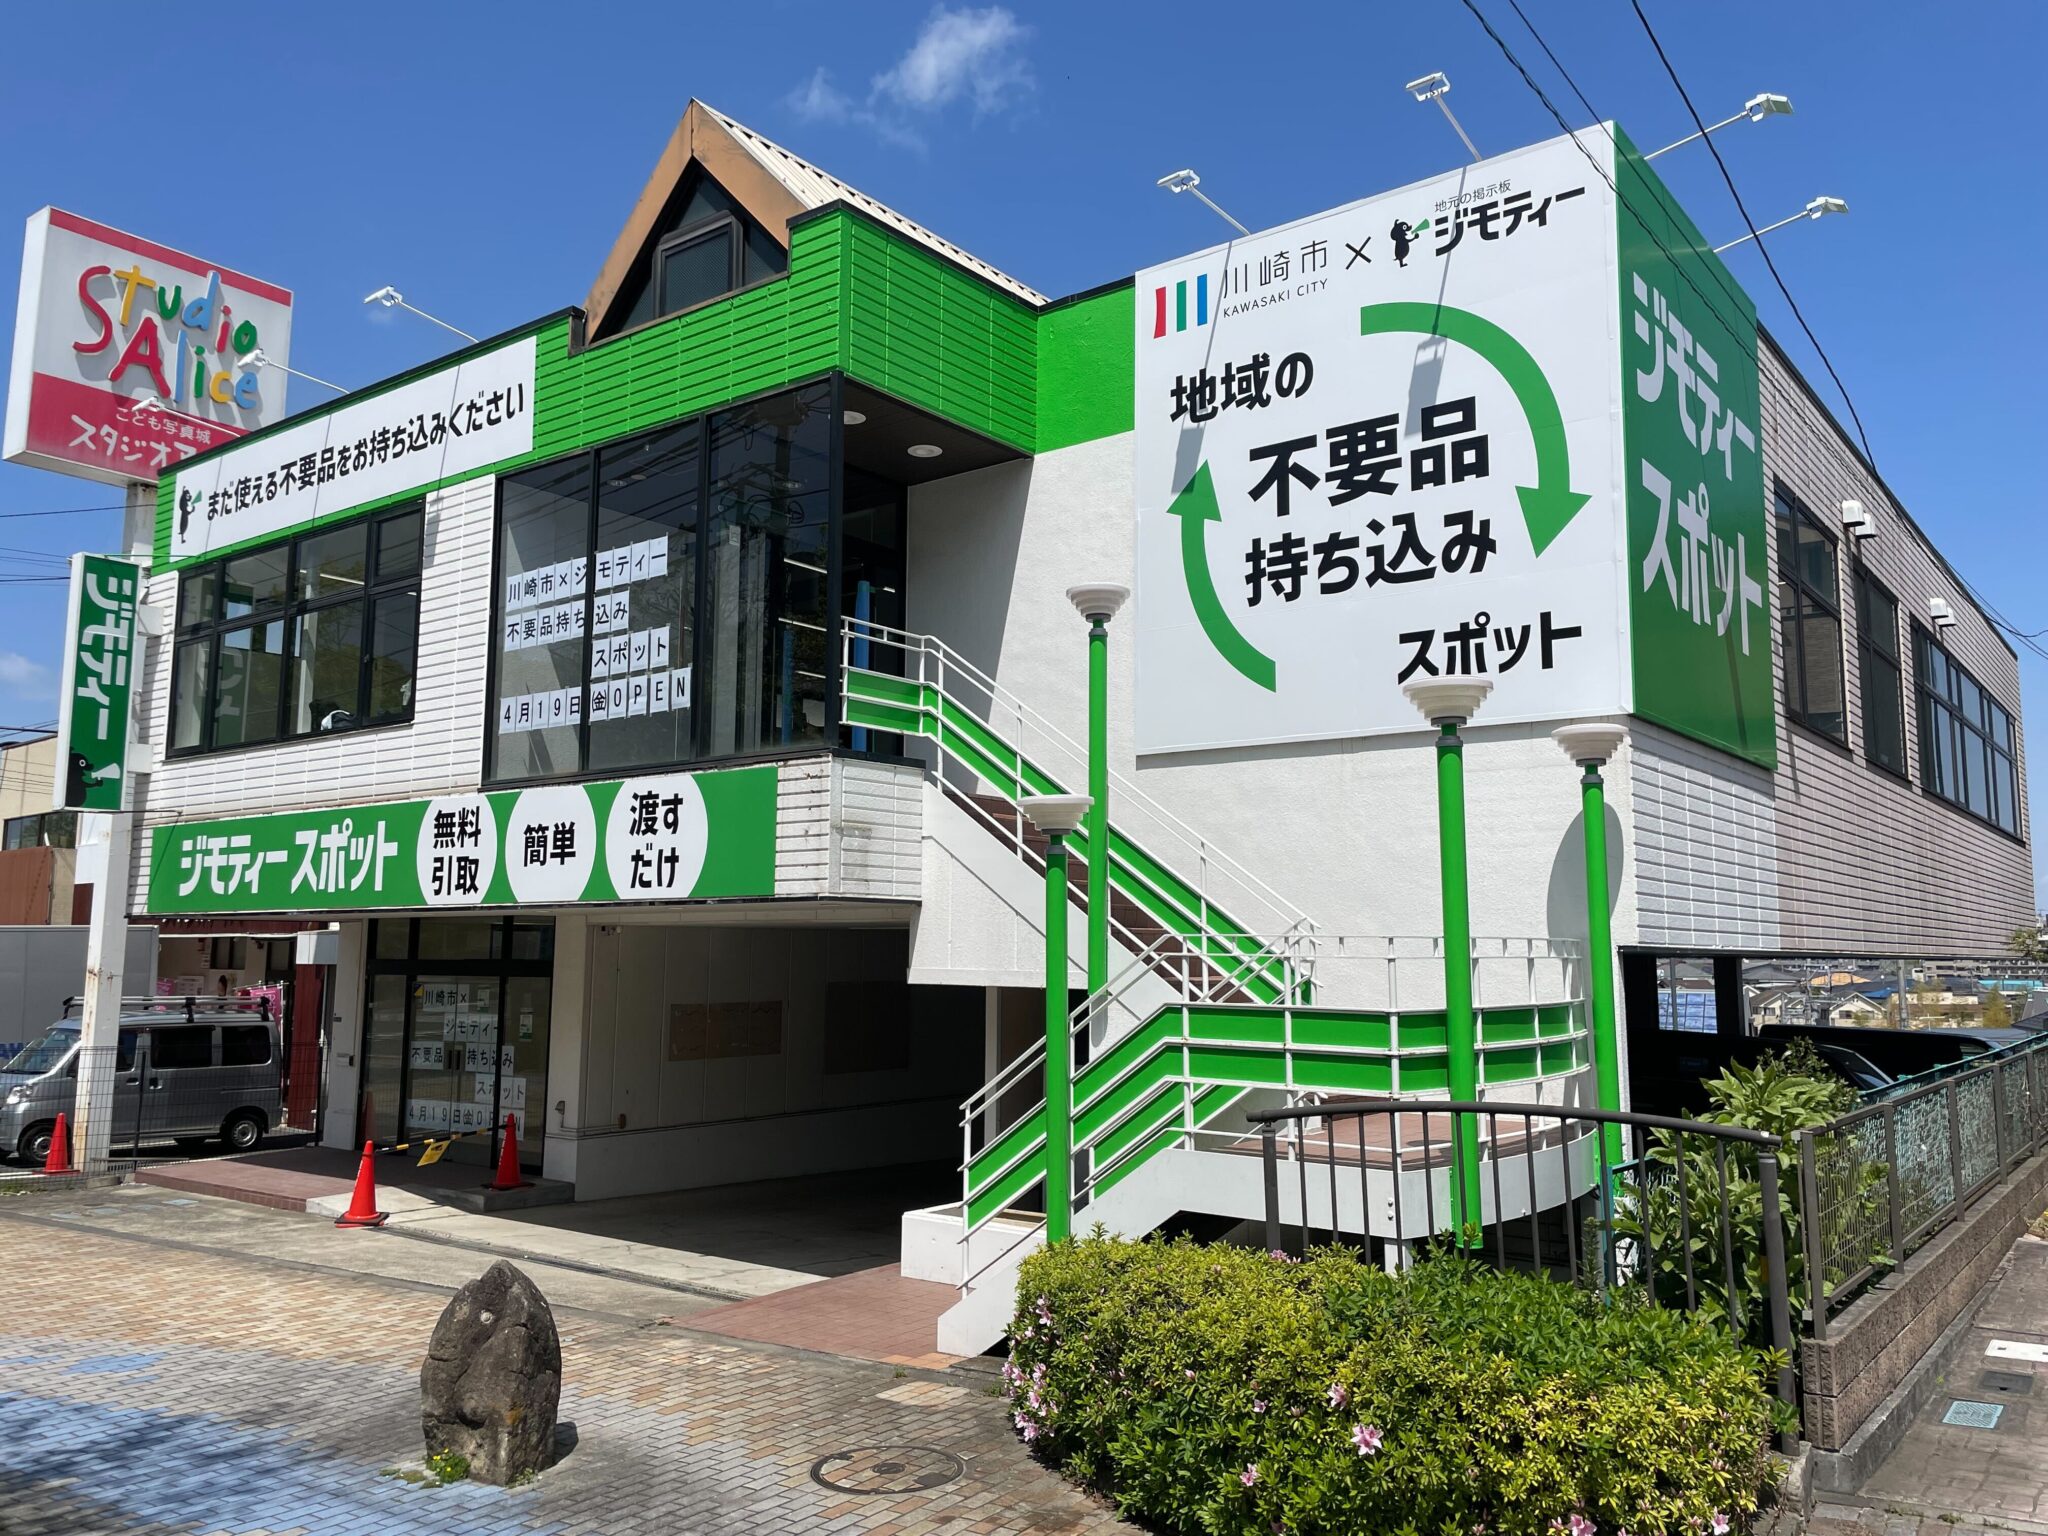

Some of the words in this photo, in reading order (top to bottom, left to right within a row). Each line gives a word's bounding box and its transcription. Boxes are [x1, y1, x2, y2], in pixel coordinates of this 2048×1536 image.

[1434, 179, 1511, 213] 地元の掲示板
[1224, 240, 1328, 299] 川崎市
[1435, 186, 1585, 257] ジモティー
[72, 265, 258, 354] Studio
[1223, 289, 1291, 318] KAWASAKI
[1296, 278, 1328, 298] CITY
[108, 316, 258, 410] Alice
[1170, 352, 1314, 424] 地域の
[1633, 272, 1755, 481] ジモティー
[116, 407, 212, 445] こども写真城
[207, 383, 524, 521] まだ使える不要品をお持ち込みください
[1248, 396, 1490, 517] 不要品
[1245, 510, 1497, 608] 持ち込み
[1642, 458, 1762, 656] スポット
[77, 572, 133, 741] ジモティー
[507, 601, 628, 643] 不要品持ち込み
[594, 636, 667, 668] スポット
[1398, 611, 1583, 686] スポット
[433, 807, 482, 850] 無料
[523, 821, 577, 868] 簡単
[628, 791, 684, 837] 渡す
[179, 835, 288, 897] ジモティー
[290, 820, 399, 895] スポット
[431, 855, 480, 897] 引取
[630, 843, 680, 890] だけ
[411, 1047, 443, 1064] 不要品
